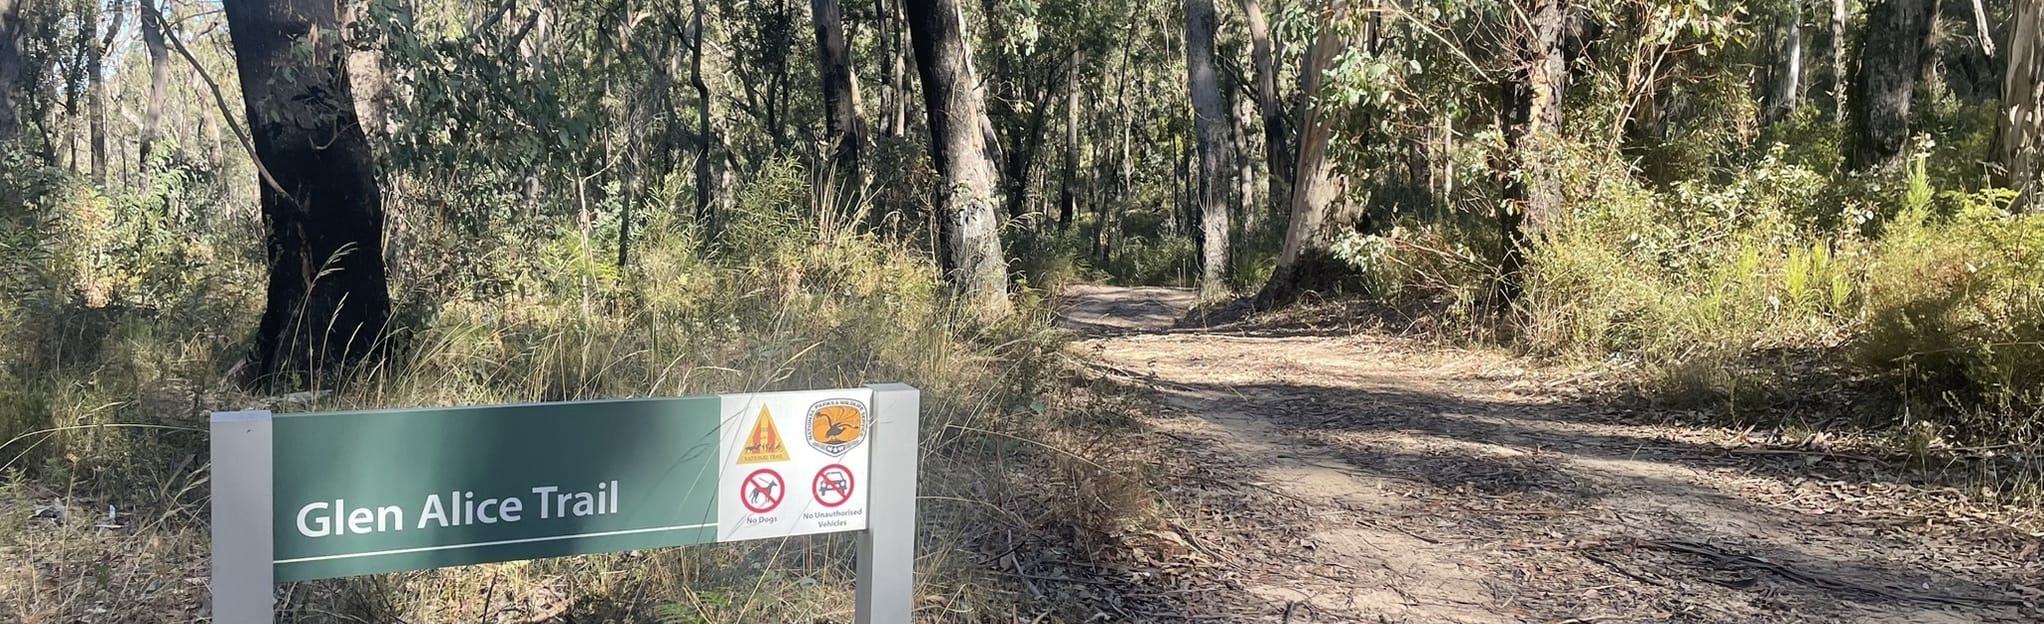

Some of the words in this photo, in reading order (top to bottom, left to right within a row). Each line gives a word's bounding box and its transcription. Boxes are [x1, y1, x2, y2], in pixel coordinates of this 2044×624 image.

[296, 498, 404, 538] Glen
[416, 491, 523, 529] Alice
[532, 480, 618, 519] Trail
[803, 512, 814, 520] No
[814, 508, 863, 519] Unauthorised
[746, 517, 758, 525] No
[758, 515, 778, 525] Dogs
[818, 519, 847, 528] Vehicles
